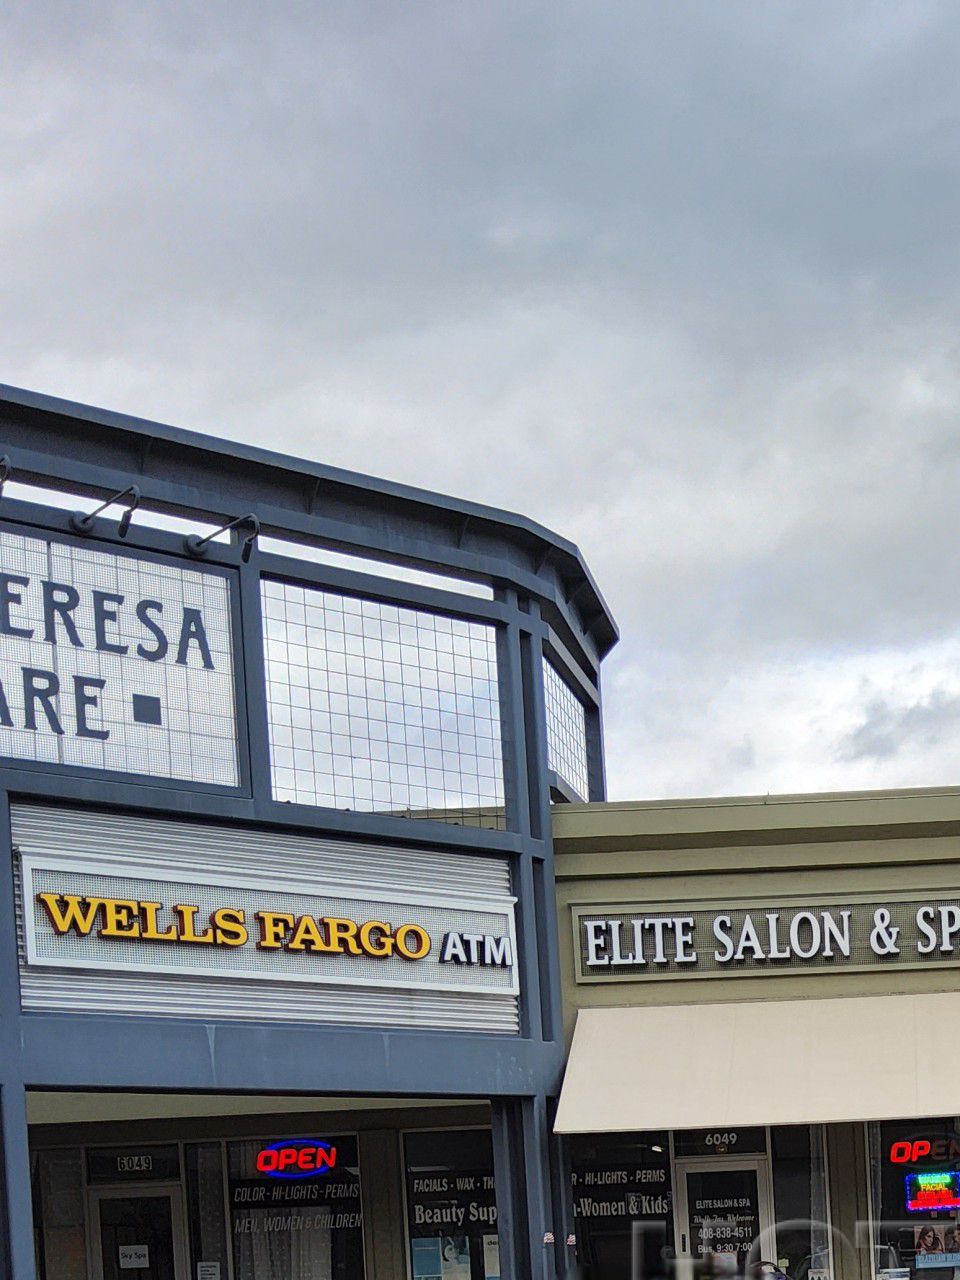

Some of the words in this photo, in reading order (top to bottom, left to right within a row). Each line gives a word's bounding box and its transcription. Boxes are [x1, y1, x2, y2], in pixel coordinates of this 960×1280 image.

[0, 572, 215, 670] ERESA
[37, 891, 250, 948] WELLS
[257, 910, 432, 961] FARGO
[440, 931, 514, 968] ATM
[584, 917, 697, 967] ELITE
[713, 910, 852, 962] SALON
[870, 907, 900, 956] &
[705, 1132, 738, 1146] 6049
[119, 1156, 152, 1171] 6049
[256, 1146, 337, 1173] OPEN
[413, 1178, 449, 1193] FACIALS
[456, 1177, 475, 1191] WAX
[584, 1171, 628, 1185] HI-LIGHTS
[635, 1169, 666, 1183] PERMS
[234, 1187, 266, 1202] COLOR
[271, 1184, 319, 1201] HI-LIGHTS
[324, 1183, 360, 1198] PERMS
[628, 1195, 639, 1215] &
[640, 1195, 669, 1215] Kids
[264, 1215, 303, 1232] WOMEN
[314, 1213, 362, 1230] CHILDREN
[414, 1204, 466, 1227] Beauty
[698, 1227, 752, 1240] 408-838-4511
